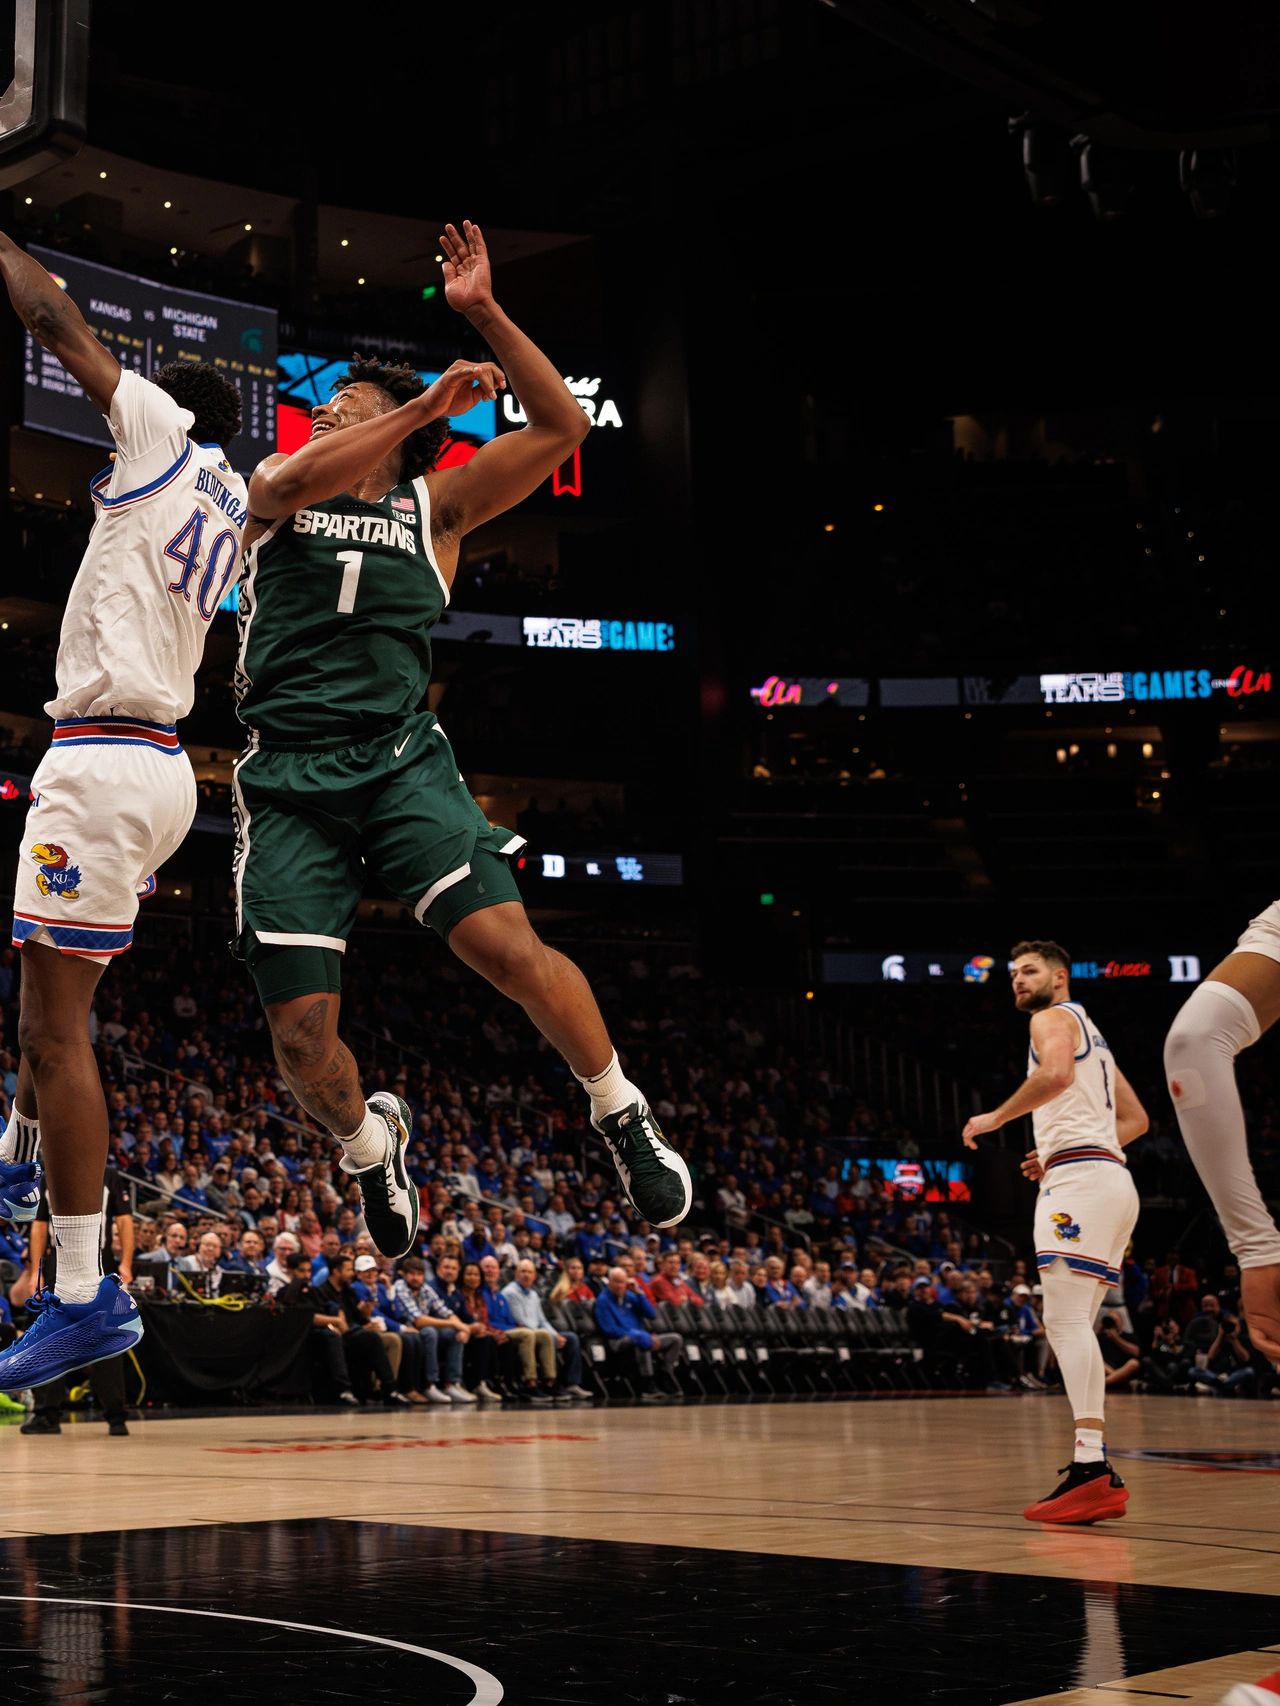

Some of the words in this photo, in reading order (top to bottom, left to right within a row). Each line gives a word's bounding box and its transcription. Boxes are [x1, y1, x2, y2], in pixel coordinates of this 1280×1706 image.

[89, 299, 132, 322] KANSAS
[162, 306, 218, 329] MICHIGAN
[172, 324, 206, 342] STATE
[503, 393, 623, 428] URA
[293, 509, 417, 556] SPARTANS
[163, 505, 242, 622] 40
[336, 550, 363, 614] 1
[1041, 683, 1125, 703] TEAMS
[1132, 669, 1213, 700] GAMES
